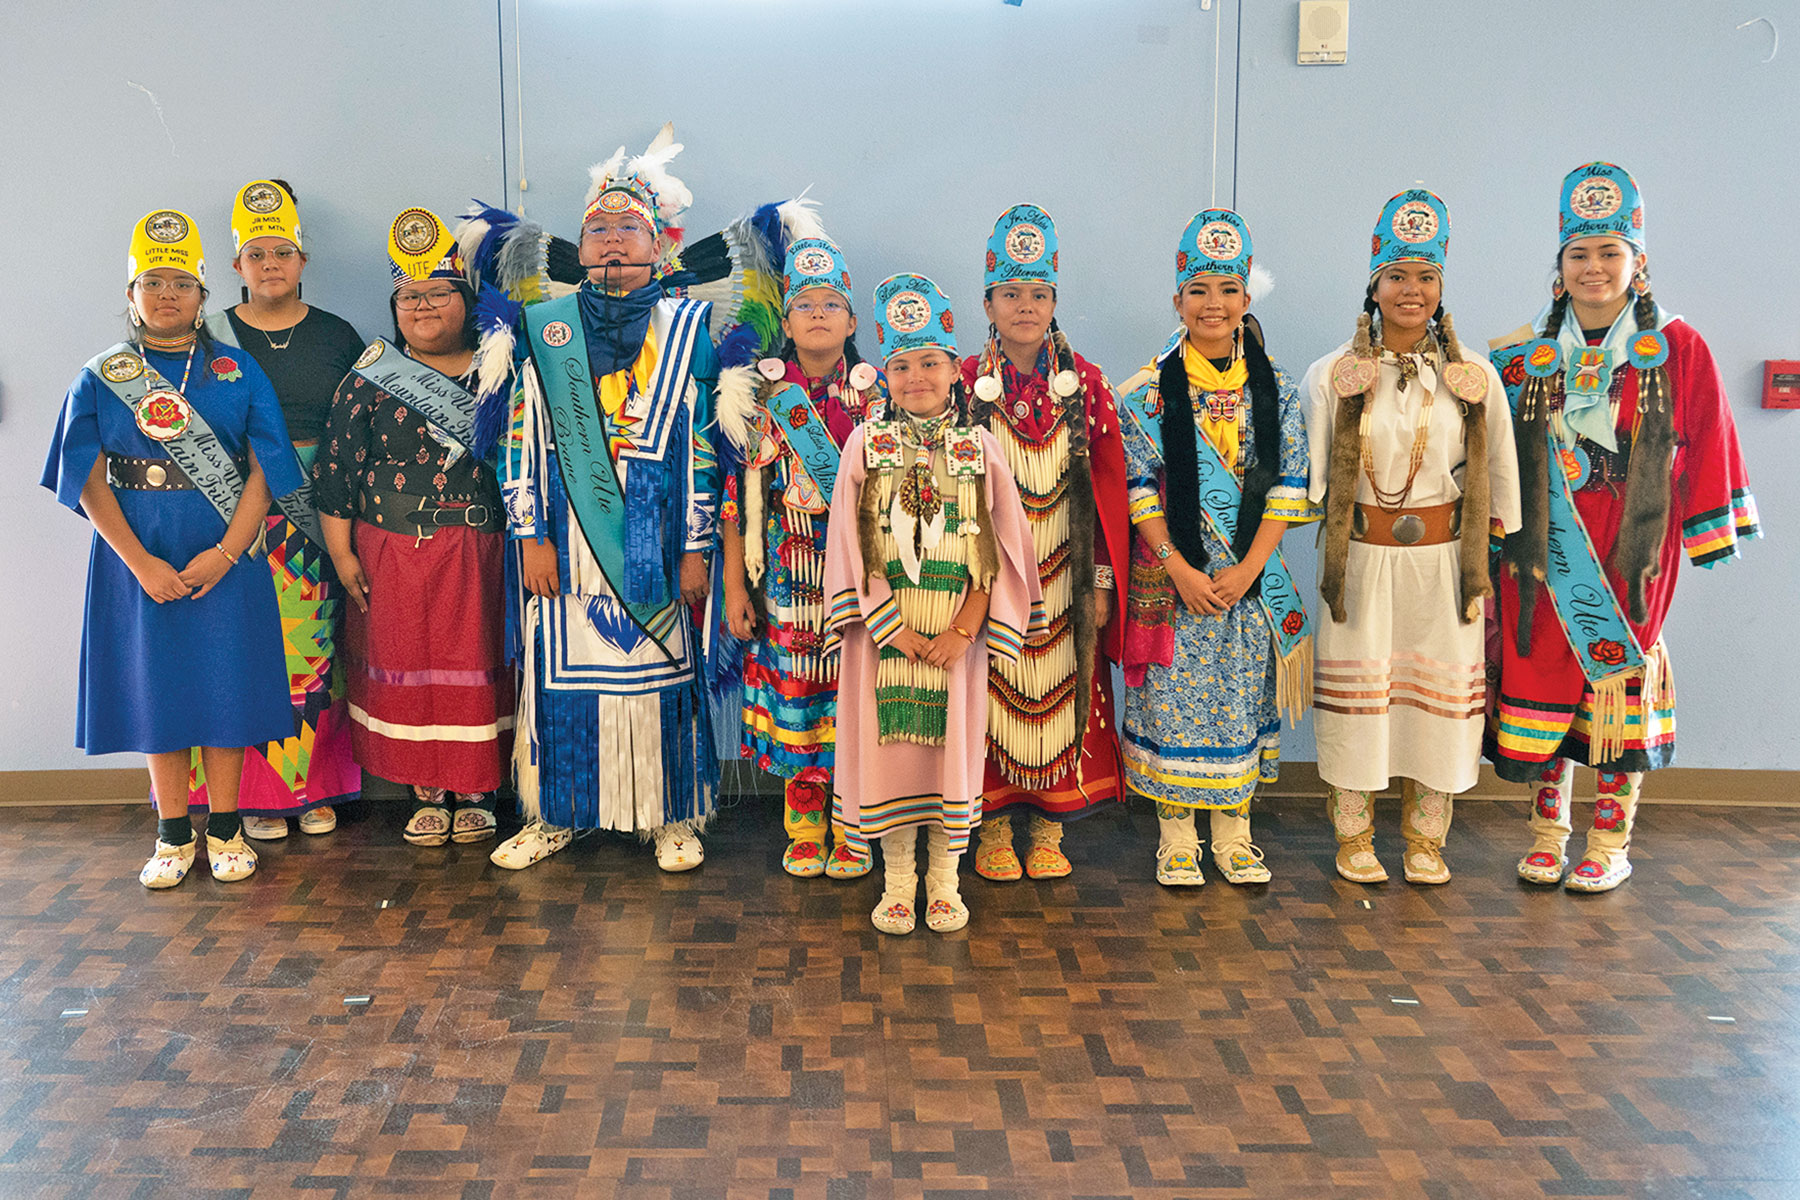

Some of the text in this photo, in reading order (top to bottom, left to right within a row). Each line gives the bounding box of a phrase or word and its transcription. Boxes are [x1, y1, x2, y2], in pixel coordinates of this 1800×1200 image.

[1581, 166, 1613, 177] Miss
[249, 224, 286, 233] UTE MTN
[1216, 213, 1240, 227] Miss
[1563, 220, 1610, 237] Southern
[145, 247, 189, 257] LITTLE MISS
[149, 255, 186, 265] UTE MTN
[407, 260, 431, 277] UTE
[1187, 260, 1234, 276] Southern
[790, 276, 831, 295] Southern
[905, 278, 931, 295] Miss
[891, 334, 937, 349] Alternate
[410, 371, 449, 398] Miss
[373, 372, 451, 427] Mountain
[554, 406, 577, 484] Brave
[561, 357, 615, 515] Southern Ute
[187, 430, 243, 499] Miss Ute
[805, 451, 837, 494] Miss
[198, 473, 233, 517] Tribe
[1264, 572, 1289, 616] Ute
[1570, 583, 1609, 638] Ute
